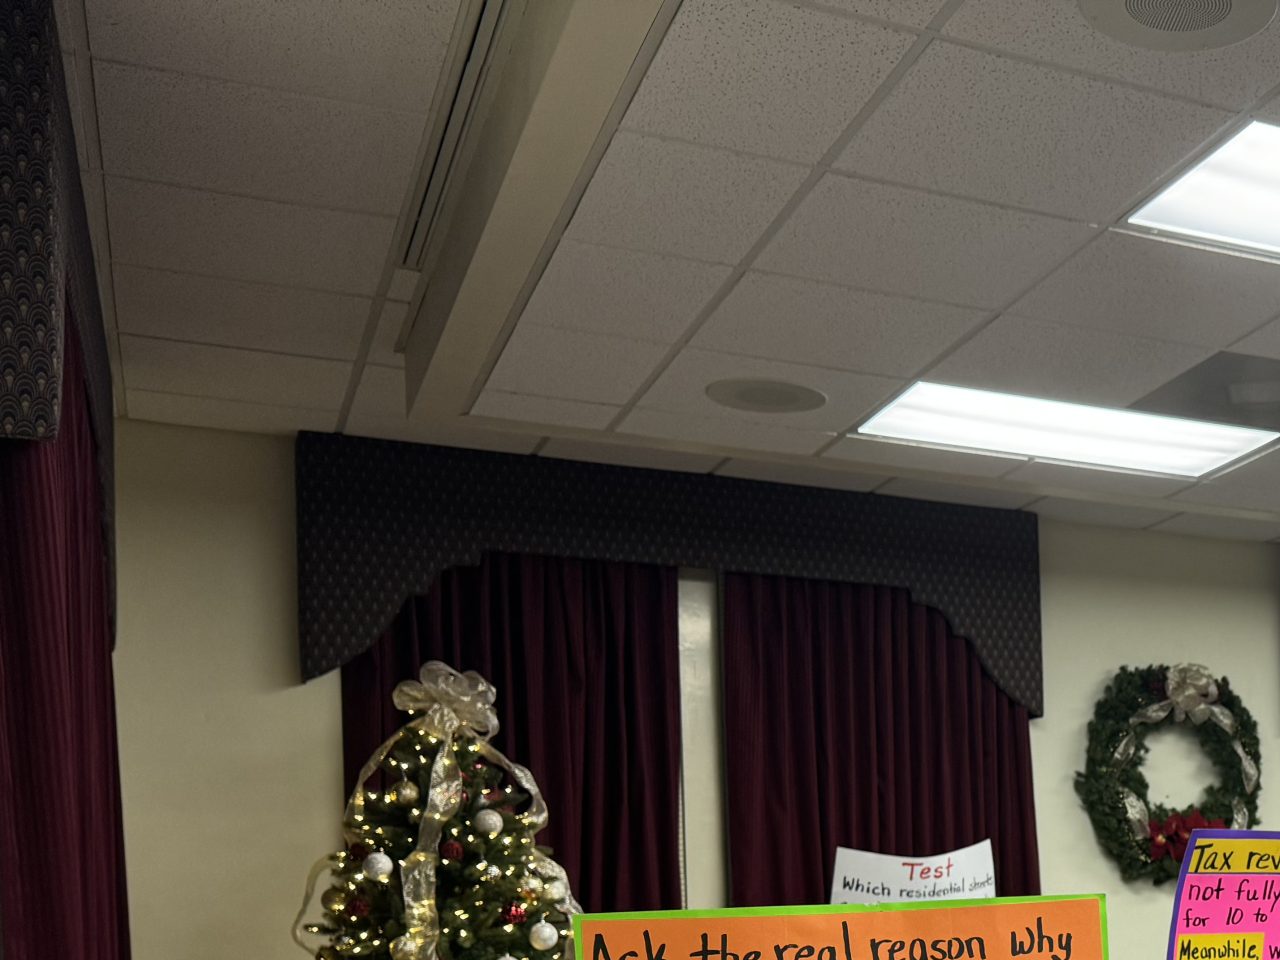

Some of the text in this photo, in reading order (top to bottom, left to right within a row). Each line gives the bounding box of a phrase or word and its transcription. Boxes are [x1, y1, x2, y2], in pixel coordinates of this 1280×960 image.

[902, 857, 954, 881] Test
[1194, 843, 1232, 873] Tax
[843, 876, 891, 897] Which
[899, 878, 965, 898] residential
[1188, 878, 1224, 901] not
[1182, 908, 1210, 928] for
[1226, 907, 1244, 925] 10
[1254, 905, 1268, 922] to
